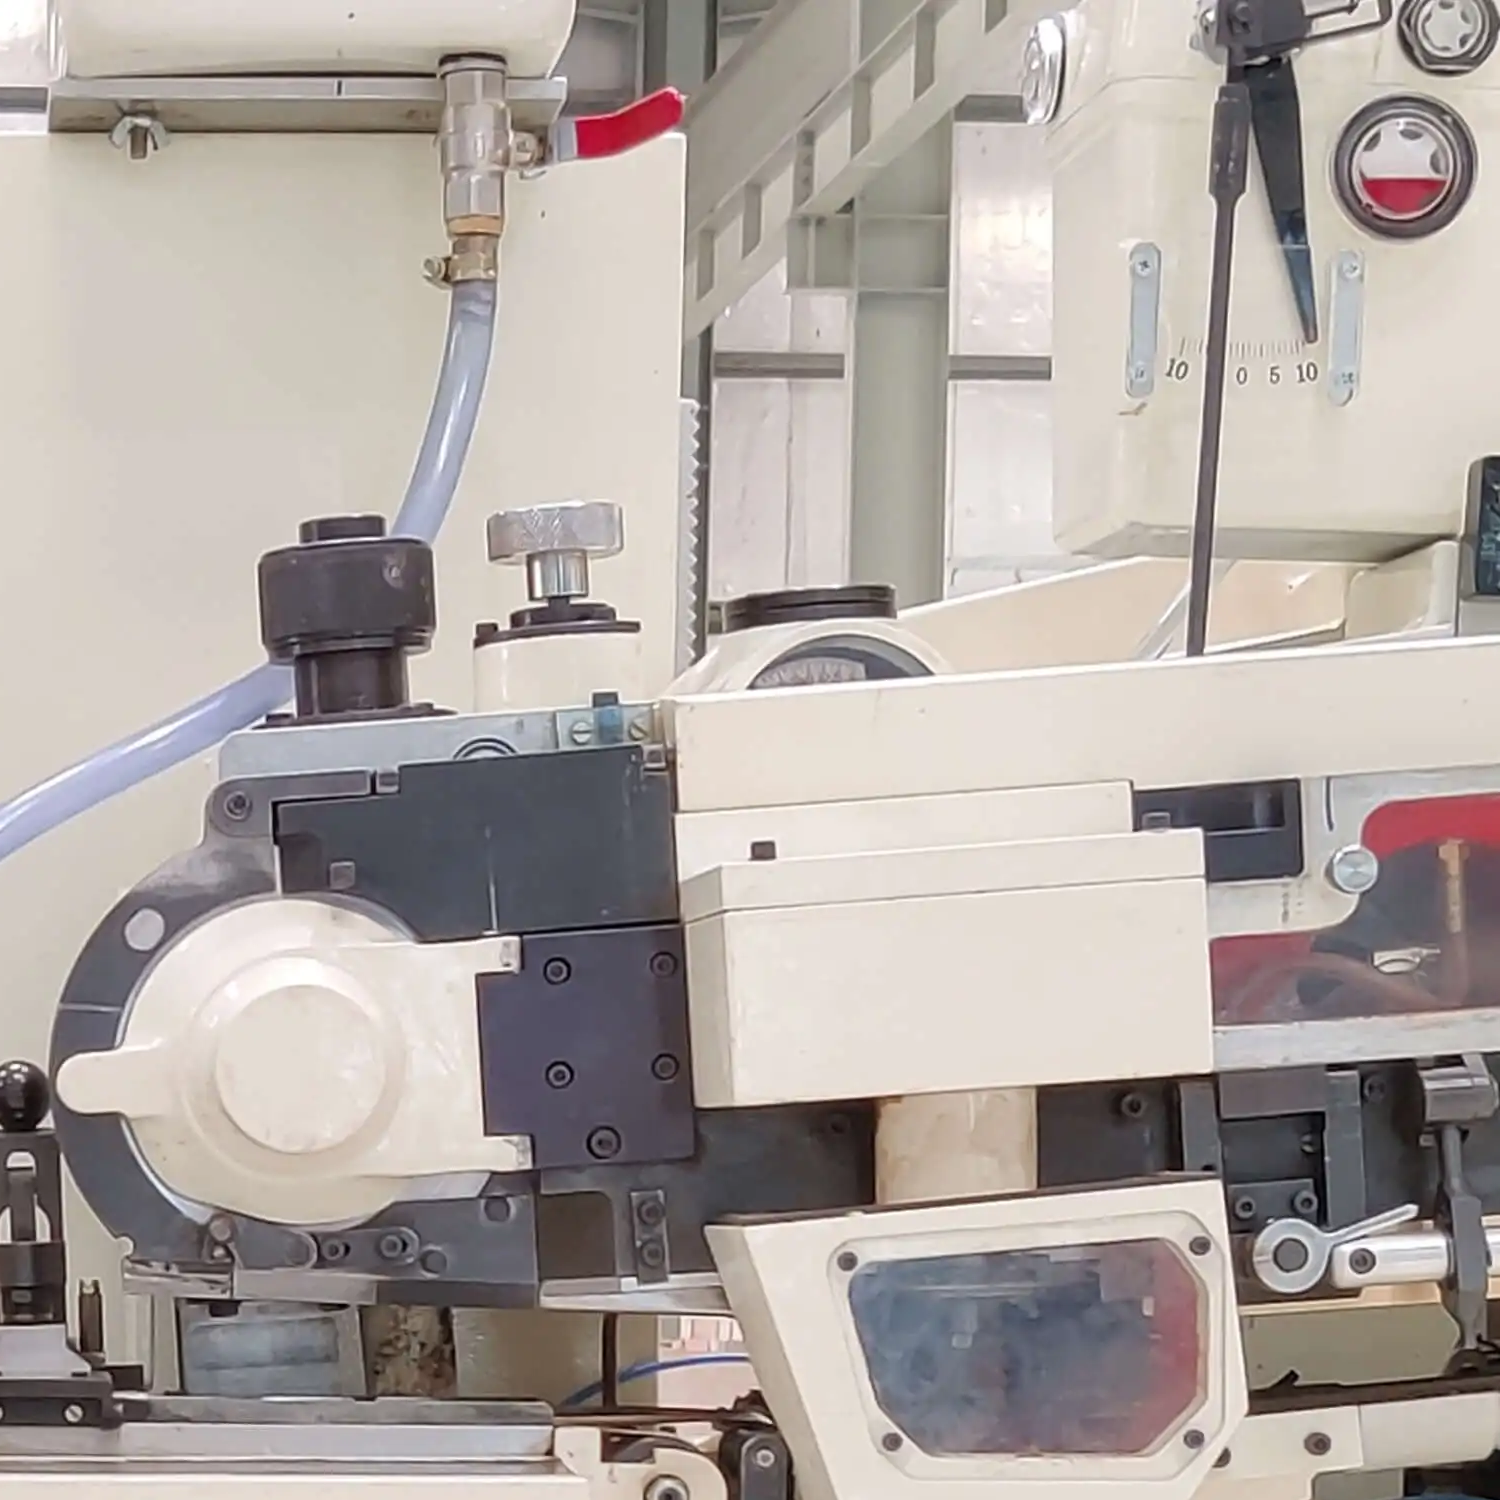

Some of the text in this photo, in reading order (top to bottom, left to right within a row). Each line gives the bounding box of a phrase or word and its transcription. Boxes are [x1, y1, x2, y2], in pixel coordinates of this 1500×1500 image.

[1165, 358, 1318, 385] 10 0 5 10
